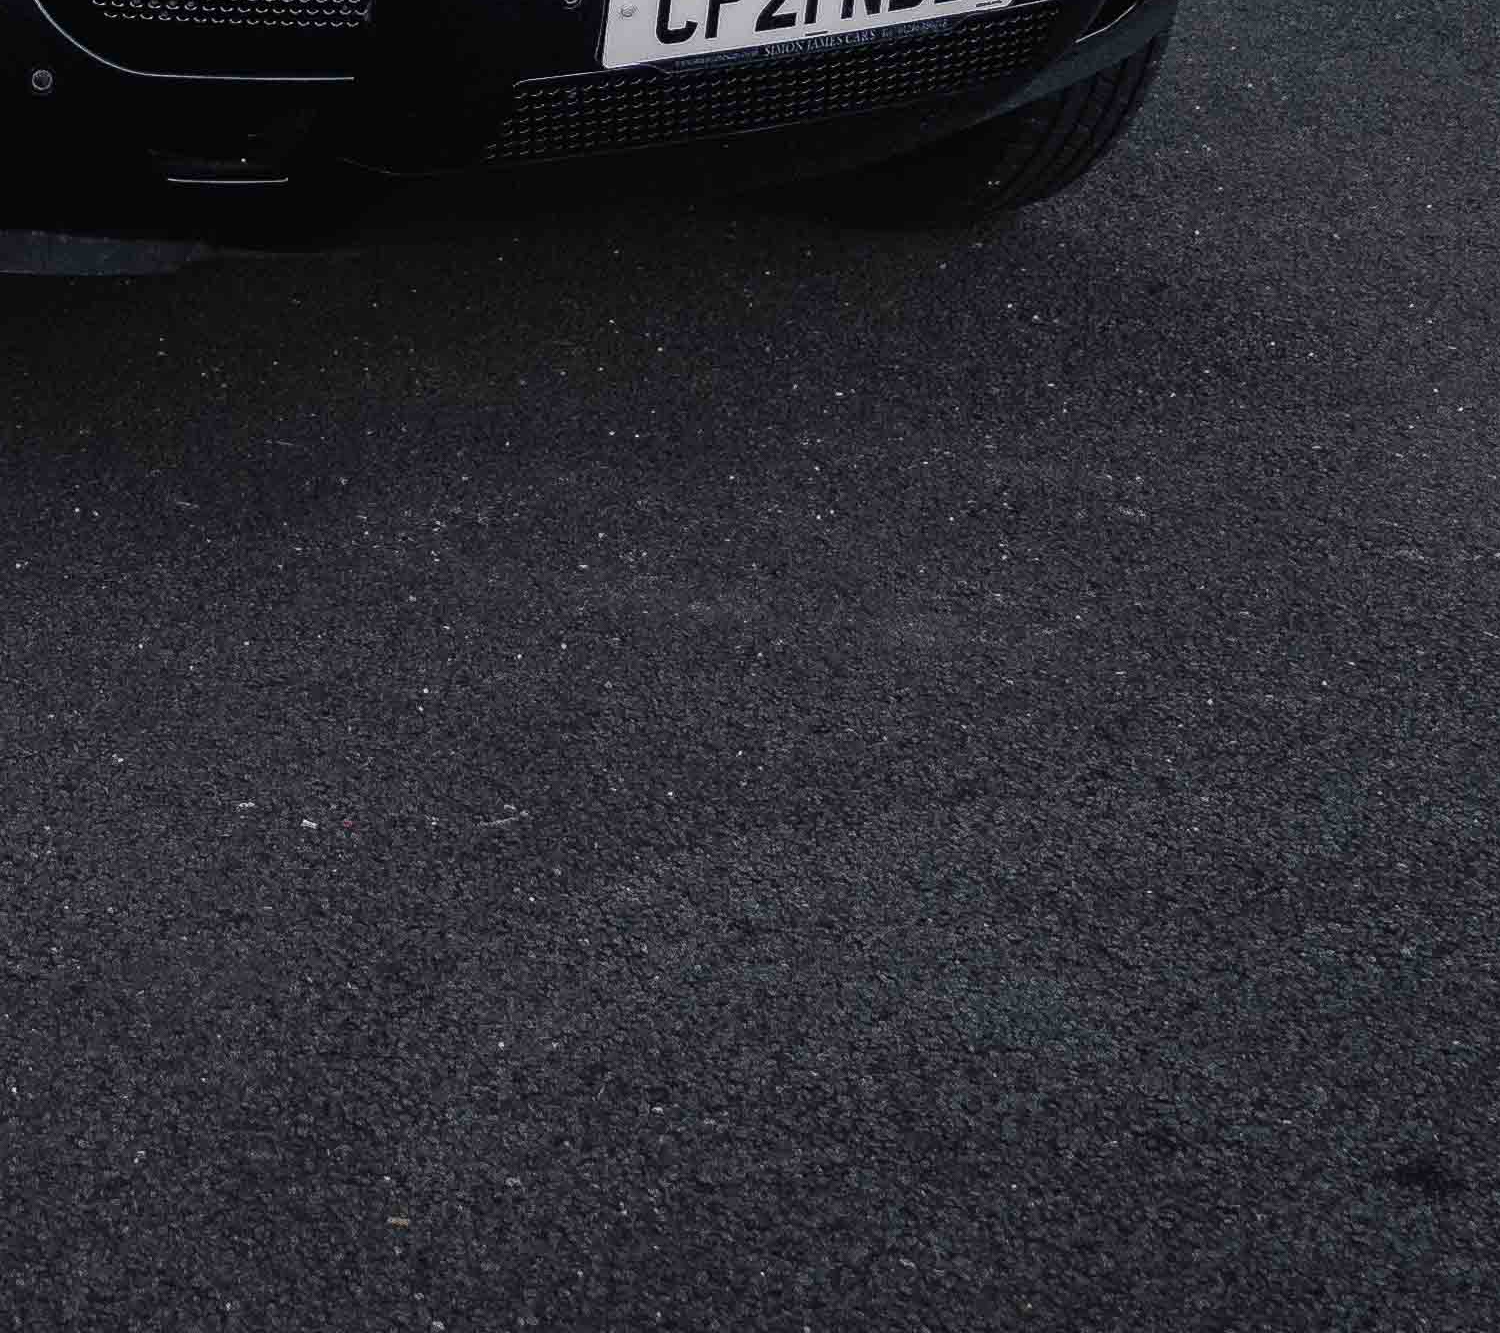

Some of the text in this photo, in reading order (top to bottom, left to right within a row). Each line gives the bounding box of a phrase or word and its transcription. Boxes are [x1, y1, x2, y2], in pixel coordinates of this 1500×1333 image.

[763, 41, 802, 57] SIMON
[806, 35, 843, 51] JAMES
[845, 30, 876, 45] CARS
